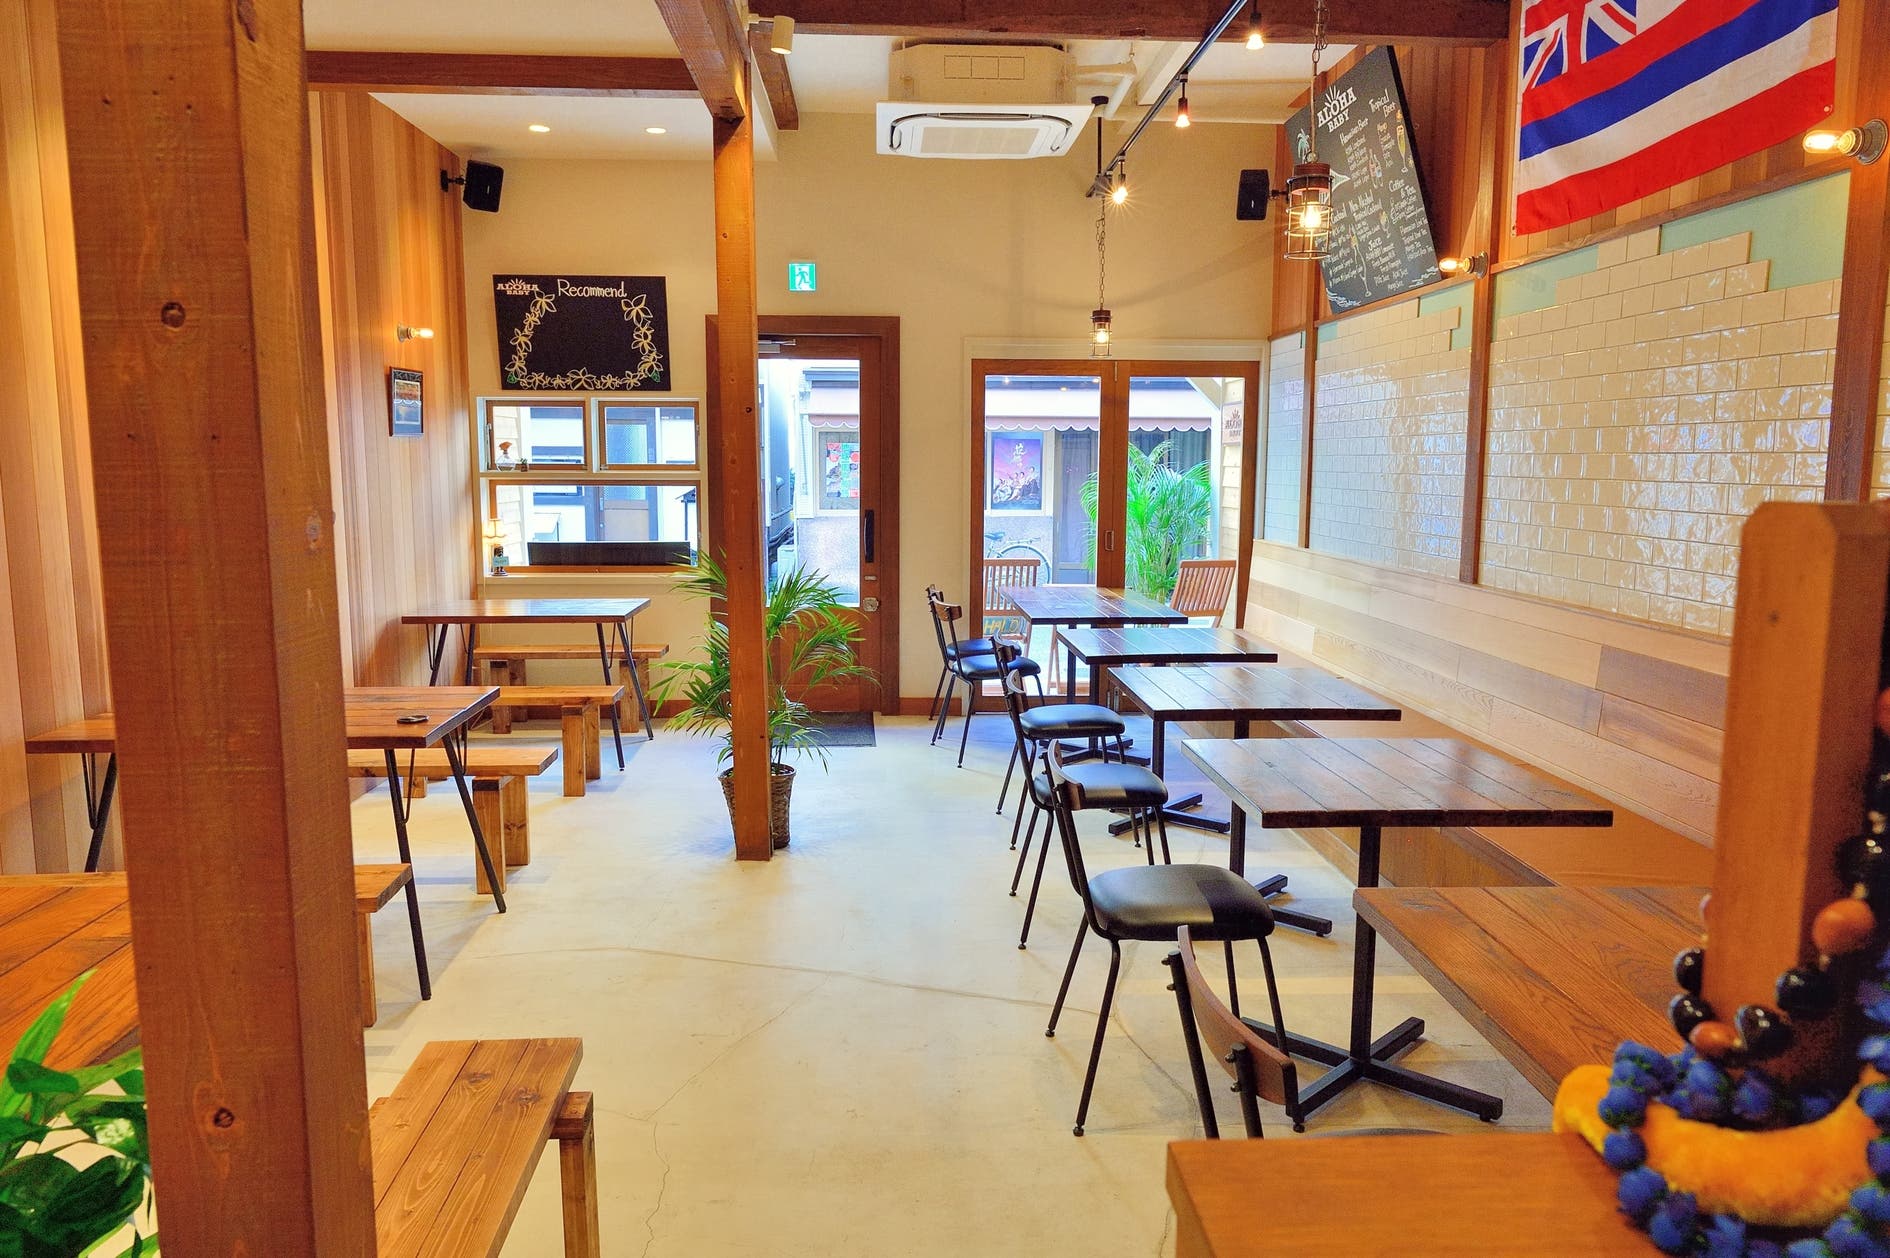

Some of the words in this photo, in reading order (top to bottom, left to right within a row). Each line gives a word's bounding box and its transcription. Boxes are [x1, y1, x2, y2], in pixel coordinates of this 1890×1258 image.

[1317, 87, 1357, 127] ALOHA
[1383, 102, 1396, 117] Beer
[1328, 108, 1349, 132] BABY
[1389, 179, 1405, 192] Coffee
[497, 283, 539, 291] ALOHA
[557, 279, 627, 297] Recommend
